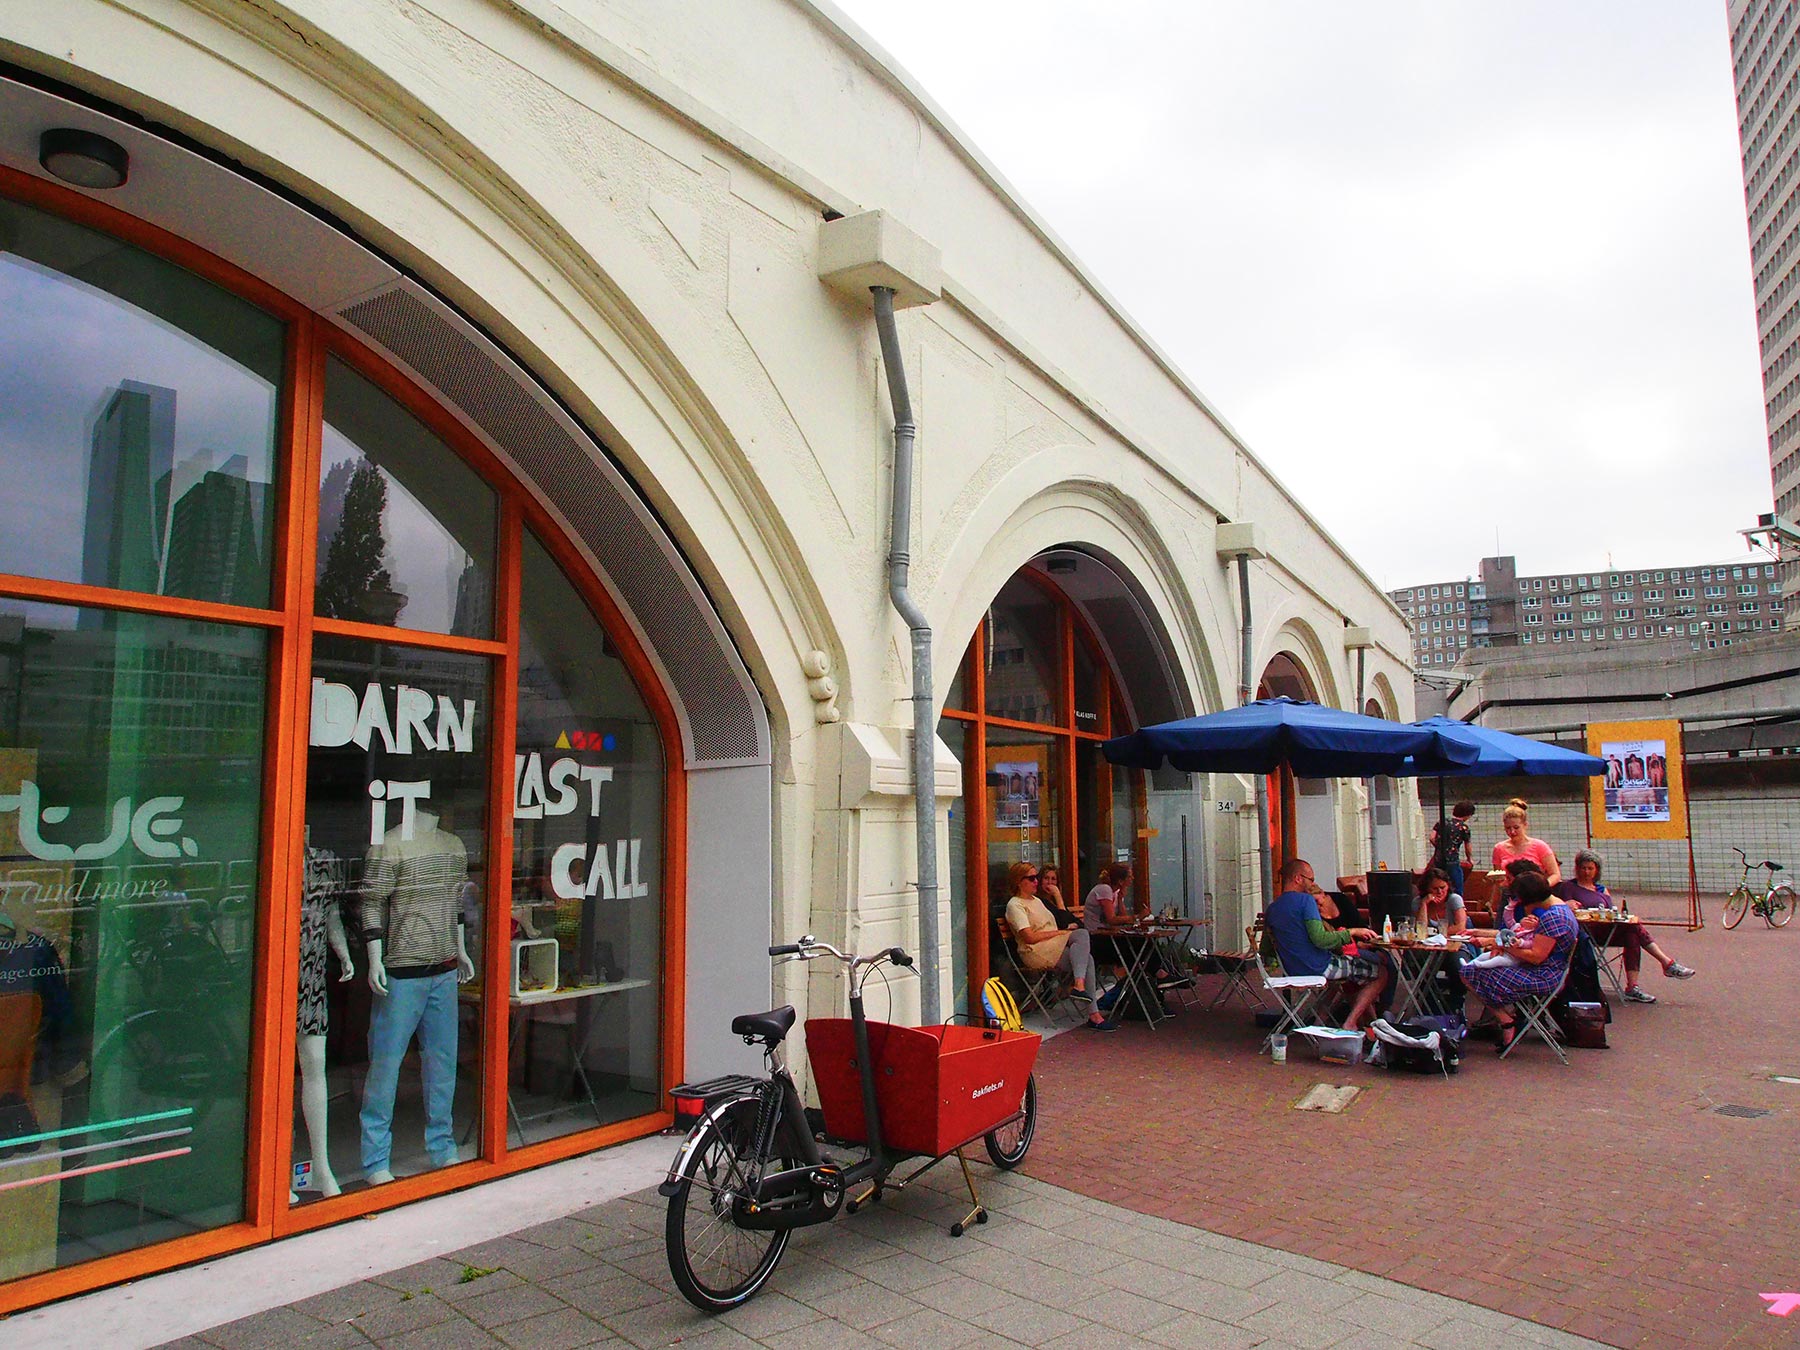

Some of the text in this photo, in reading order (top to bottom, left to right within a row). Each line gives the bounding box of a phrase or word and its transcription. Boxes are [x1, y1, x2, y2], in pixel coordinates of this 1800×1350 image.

[309, 678, 476, 754] DARN
[513, 752, 614, 819] LAST
[21, 870, 91, 903] and
[550, 838, 649, 899] CALL
[0, 938, 23, 954] op
[972, 1079, 1004, 1099] Bakfiets.nl
